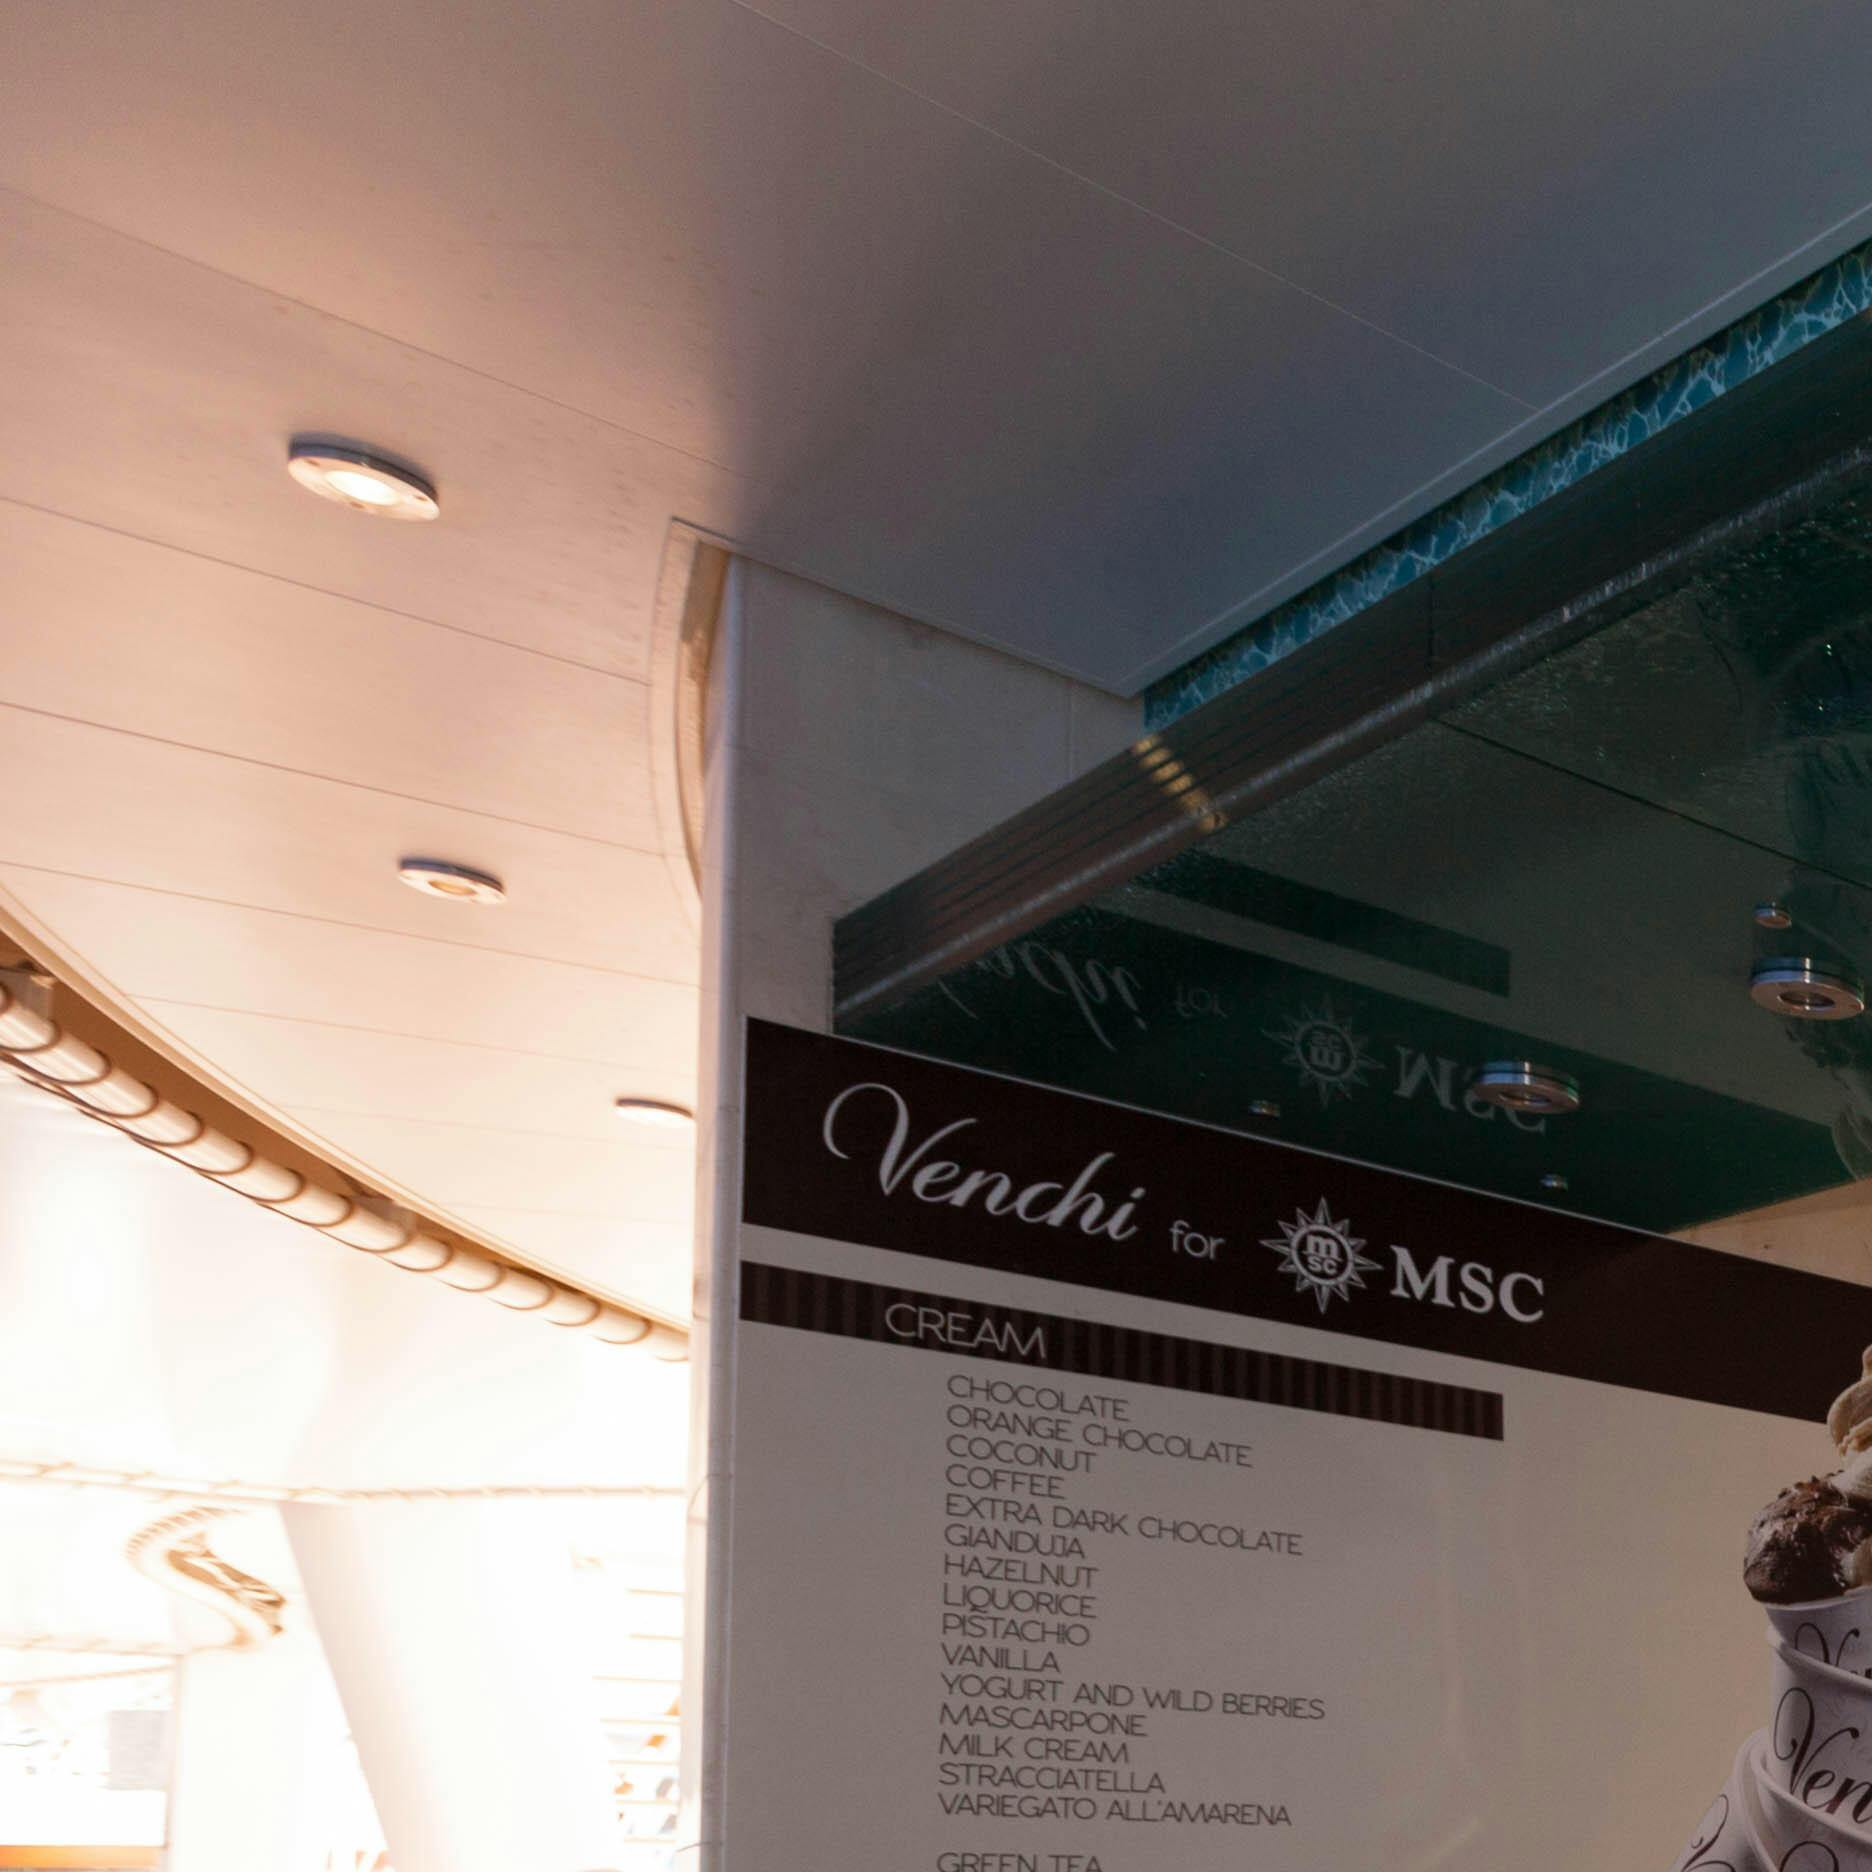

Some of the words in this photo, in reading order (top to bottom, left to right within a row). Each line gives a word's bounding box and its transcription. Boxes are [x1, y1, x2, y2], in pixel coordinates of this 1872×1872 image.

[822, 1081, 1147, 1242] Venchi
[1169, 1220, 1227, 1261] for
[1389, 1243, 1546, 1324] MSC
[884, 1301, 1048, 1360] CREAM
[946, 1374, 1131, 1423] CHOCOLATE
[945, 1403, 1073, 1443] ORANGE
[1082, 1423, 1254, 1468] CHOCOLATE
[945, 1434, 1098, 1474] COCONUT
[945, 1463, 1066, 1500] COFFEE
[944, 1522, 1086, 1560] GIANDUJA
[945, 1492, 1043, 1526] EXTRA
[1052, 1504, 1130, 1537] DARK
[1137, 1515, 1304, 1556] CHOCOLATE
[944, 1552, 1100, 1589] HAZELNUT
[942, 1582, 1098, 1619] LIQUORICE
[942, 1613, 1091, 1647] PISTACHIO
[941, 1642, 1061, 1673] VANILLA
[940, 1672, 1066, 1703] YOGURT
[1073, 1682, 1135, 1707] AND
[1142, 1686, 1213, 1713] WILD
[1222, 1692, 1327, 1720] BERRIES
[939, 1702, 1149, 1737] MASCARPONE
[939, 1732, 1015, 1759] MILK
[1024, 1736, 1130, 1764] CREAM
[938, 1762, 1166, 1794] STRACCIATELLA
[937, 1792, 1097, 1820] VARIEGATO
[1106, 1799, 1293, 1827] ALL'AMARENA
